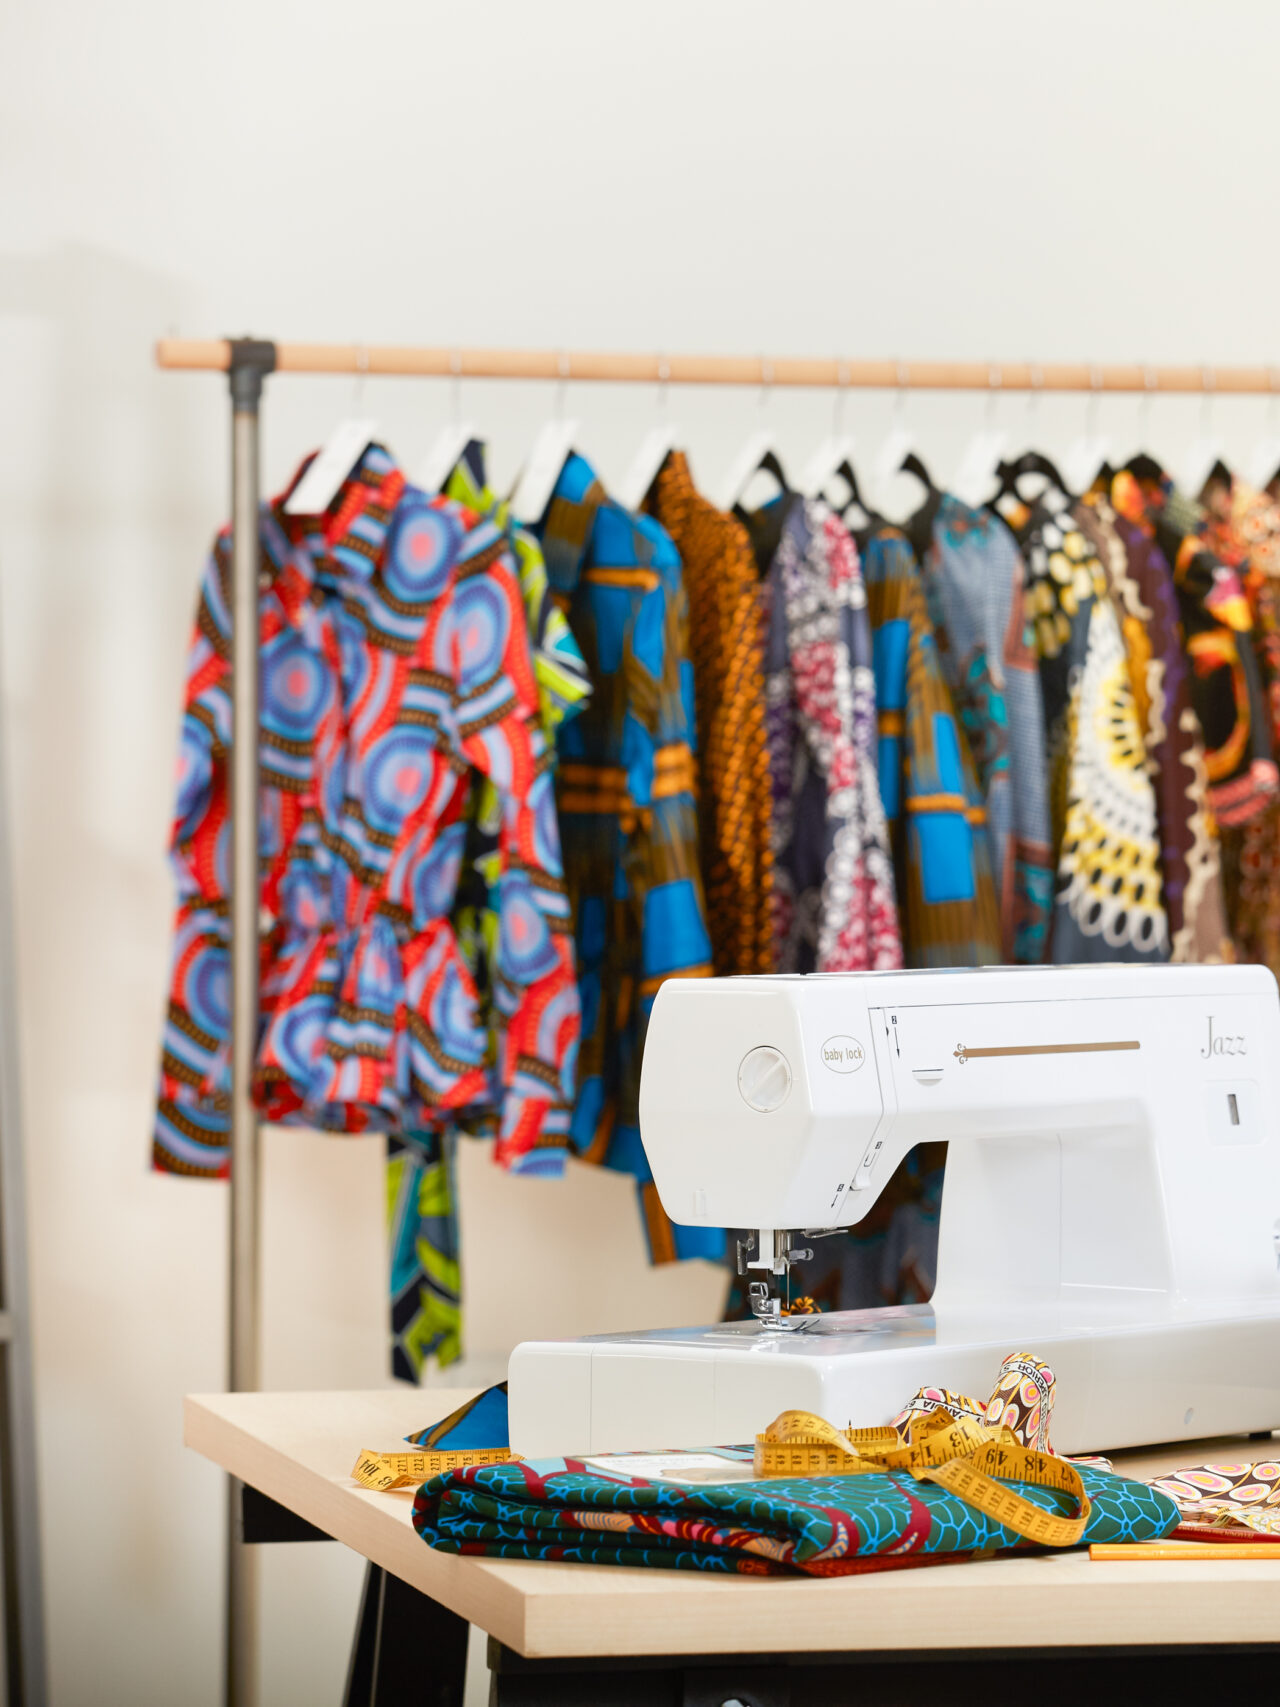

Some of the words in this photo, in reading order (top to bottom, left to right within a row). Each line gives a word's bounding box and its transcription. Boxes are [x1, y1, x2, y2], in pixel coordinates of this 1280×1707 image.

[1201, 1016, 1246, 1059] Jazz
[824, 1048, 843, 1062] baby
[845, 1047, 862, 1060] lock
[950, 1426, 970, 1447] 13
[398, 1460, 406, 1472] 271
[414, 1459, 424, 1471] 272
[431, 1458, 440, 1470] 273
[463, 1456, 472, 1465] 75
[986, 1448, 1008, 1465] 49
[1025, 1455, 1048, 1472] 48
